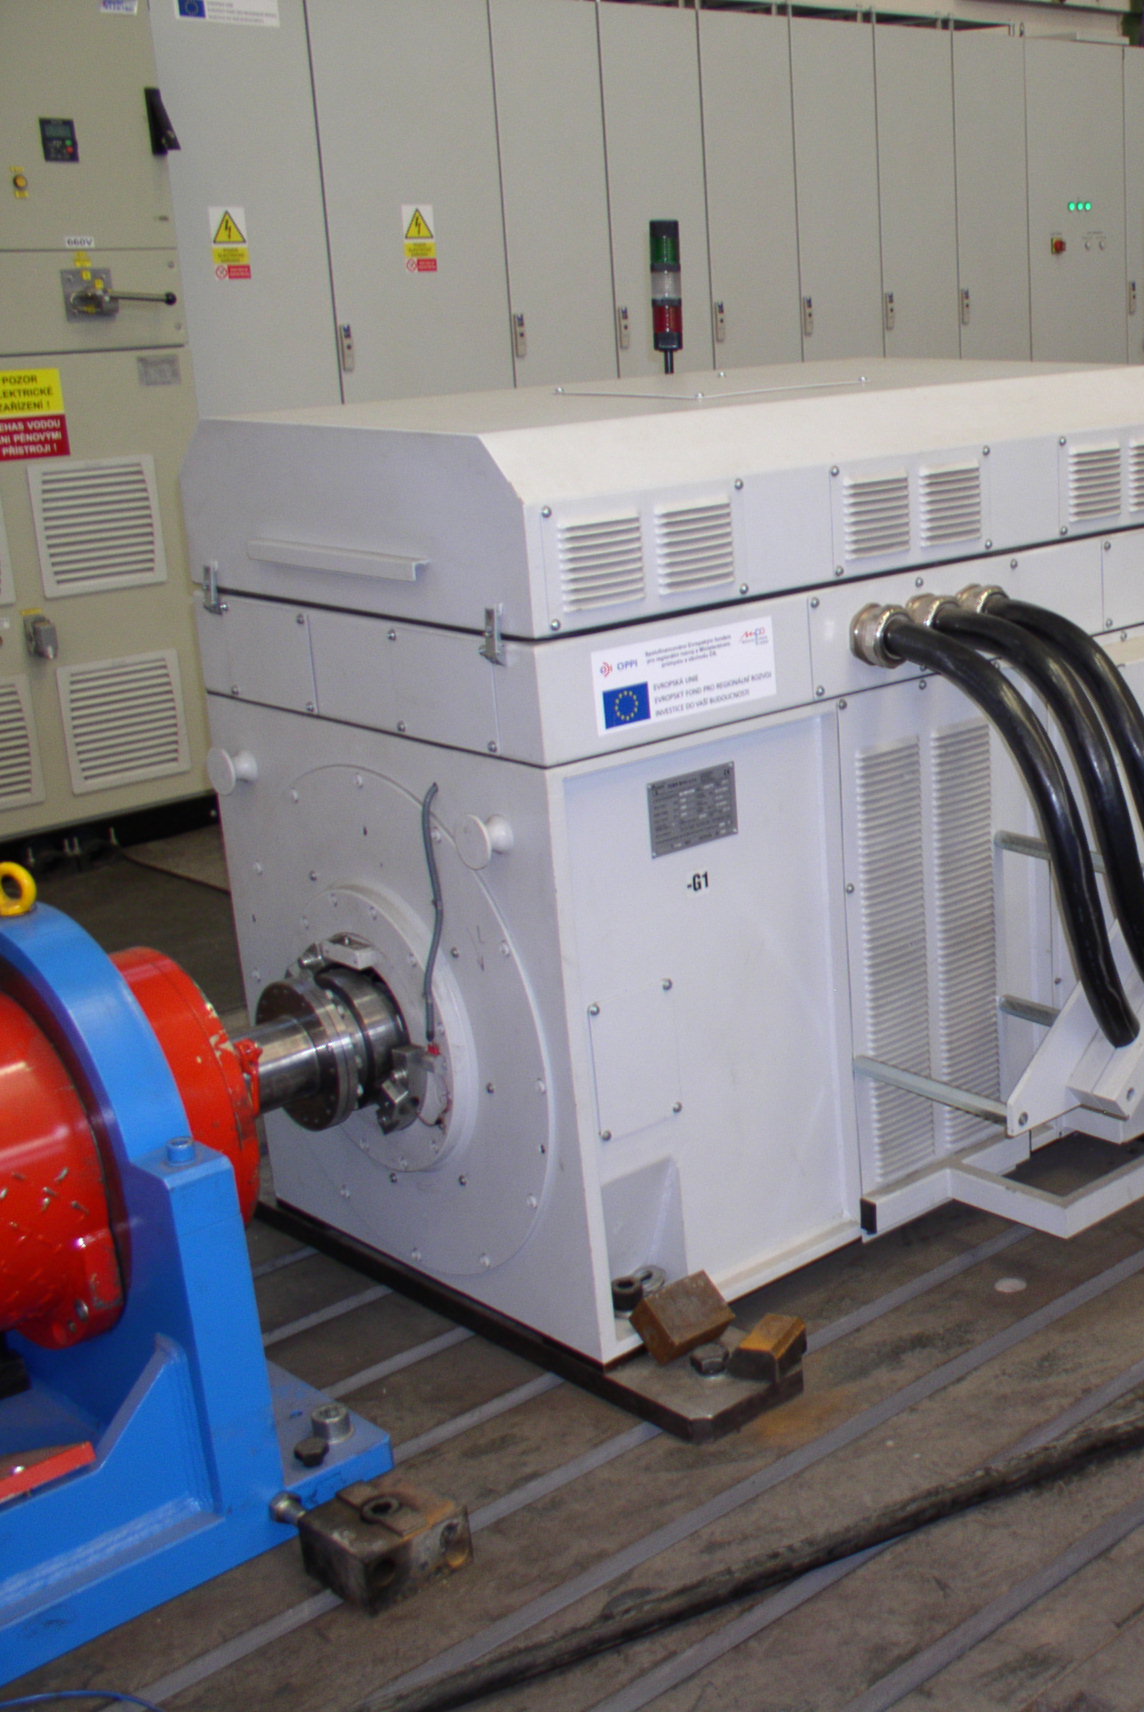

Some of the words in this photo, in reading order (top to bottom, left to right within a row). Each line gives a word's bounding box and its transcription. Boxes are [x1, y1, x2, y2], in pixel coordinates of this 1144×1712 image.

[2, 374, 38, 384] POZOR
[0, 386, 53, 399] EKTRICKÉ
[27, 418, 61, 430] VODOU
[687, 871, 709, 892] -G1
